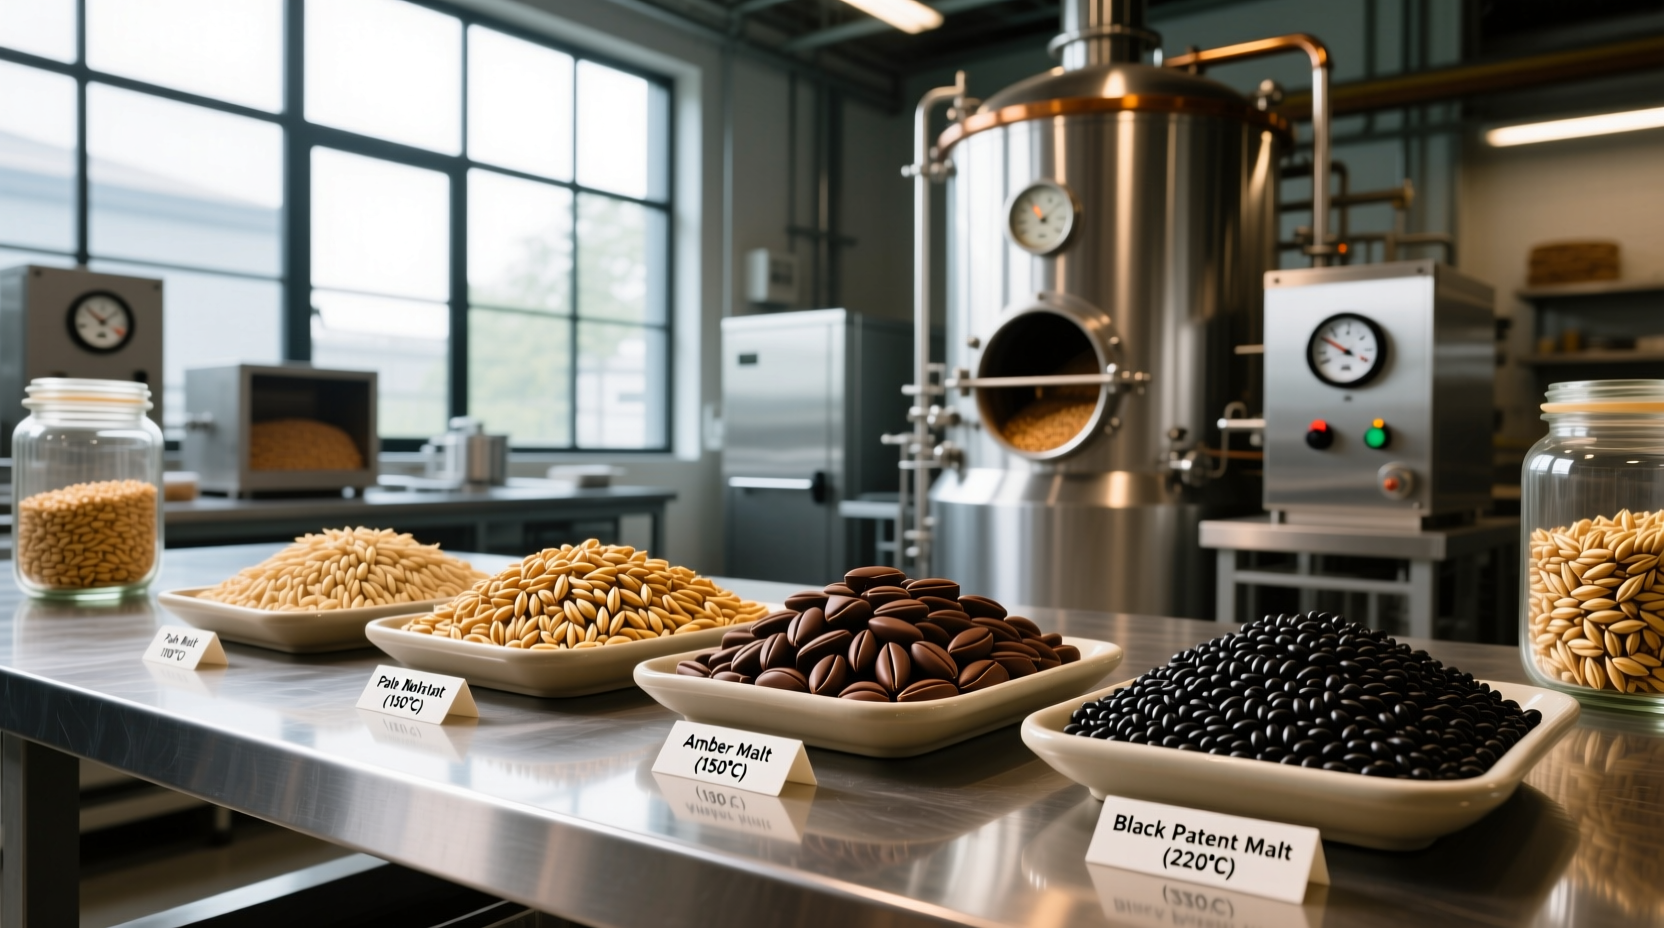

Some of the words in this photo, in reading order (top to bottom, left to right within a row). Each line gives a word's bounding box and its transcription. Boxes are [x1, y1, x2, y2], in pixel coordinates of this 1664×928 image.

[383, 694, 424, 715] (150°C)
[683, 734, 734, 754] Amber
[736, 742, 772, 762] Malt
[694, 756, 747, 783] (150°C)
[1113, 814, 1166, 839] Black
[1172, 823, 1238, 850] Patent
[1244, 836, 1293, 861] Malt
[1163, 847, 1235, 880] (220°C)
